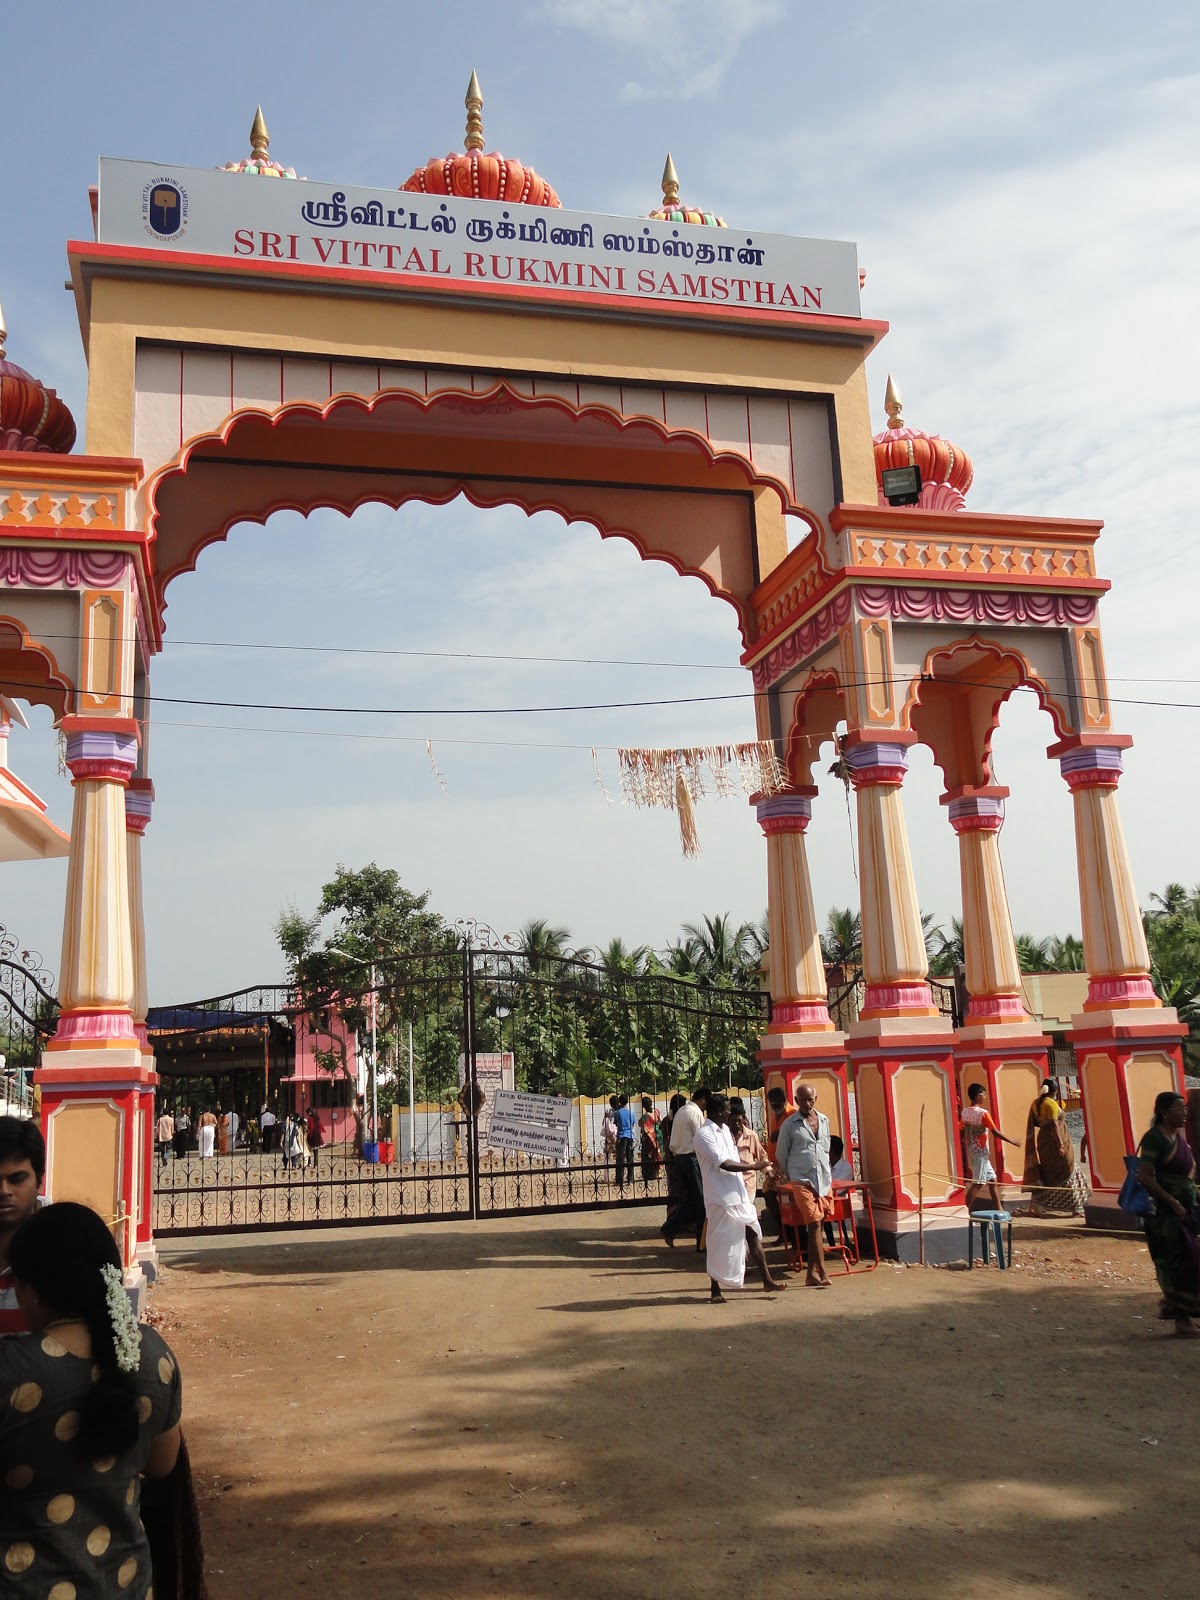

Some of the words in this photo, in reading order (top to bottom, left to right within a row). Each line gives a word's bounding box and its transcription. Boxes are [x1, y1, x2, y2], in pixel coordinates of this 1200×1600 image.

[151, 177, 180, 187] RUKMINI
[466, 211, 594, 248] ருக்மிணி
[602, 227, 765, 266] ஸம்ஸ்தான்
[233, 229, 300, 260] SRI
[311, 237, 451, 274] VITTAL
[463, 252, 627, 290] RUKMINI
[637, 269, 823, 310] SAMSTHAN
[490, 1135, 504, 1144] DONT
[505, 1138, 523, 1147] ENTER
[523, 1142, 547, 1151] WEARING
[547, 1146, 564, 1154] LUNGI
